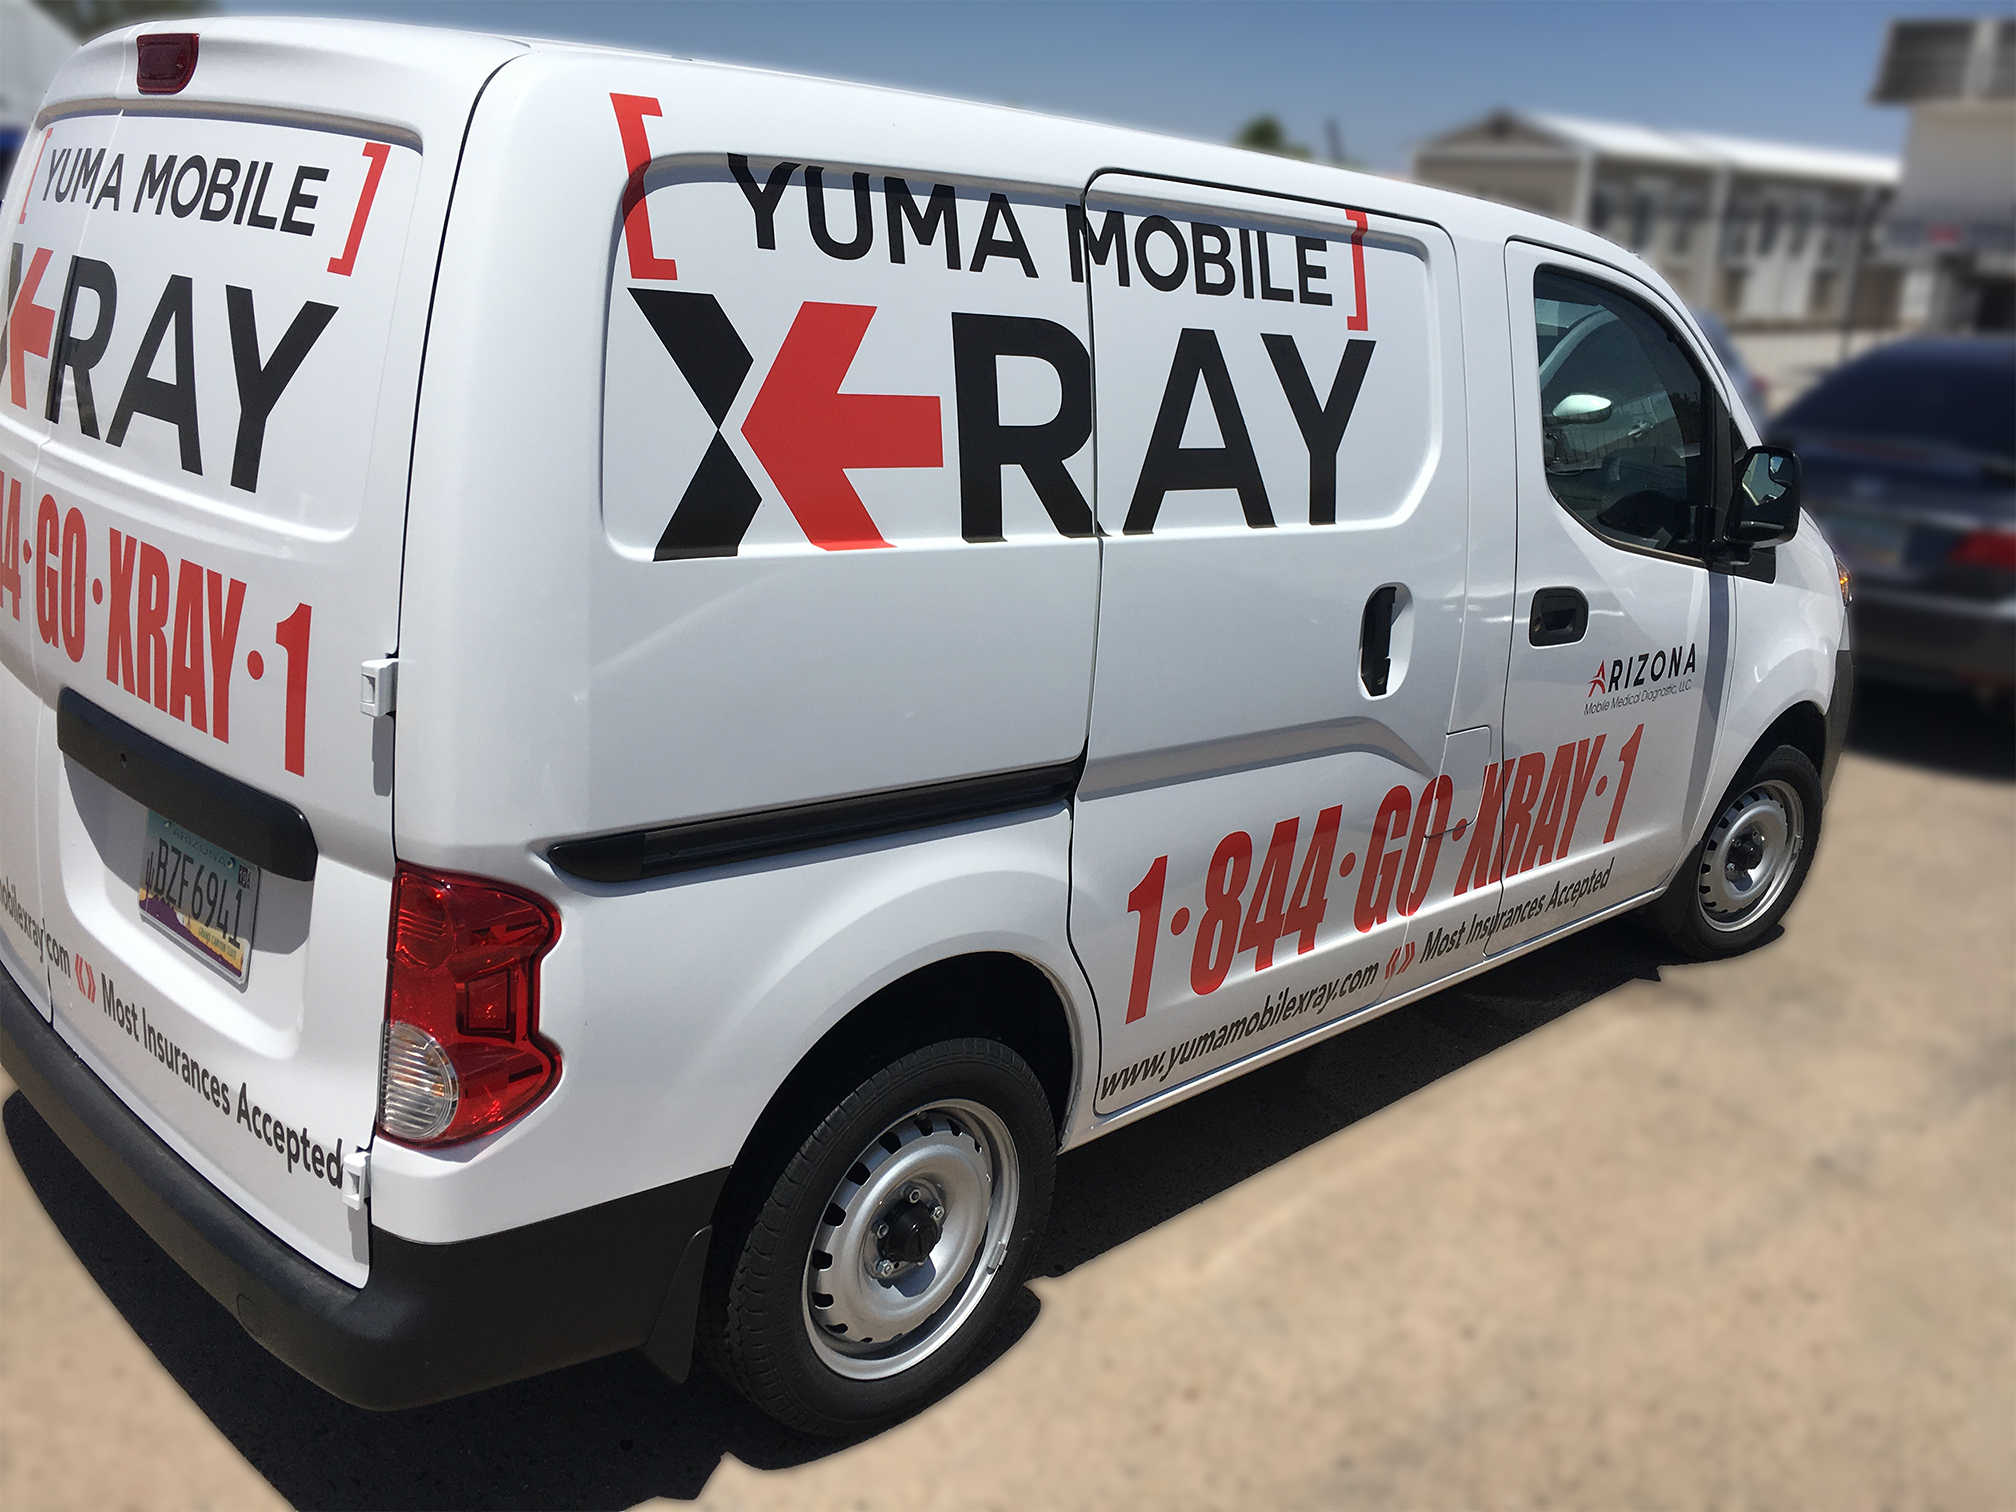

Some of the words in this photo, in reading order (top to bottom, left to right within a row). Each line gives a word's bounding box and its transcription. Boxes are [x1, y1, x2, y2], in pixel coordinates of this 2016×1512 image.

[42, 147, 126, 212] YUMA
[132, 153, 330, 237] MOBILE
[726, 152, 1039, 279] YUMA
[1065, 203, 1334, 307] MOBILE
[1584, 702, 1611, 716] Mobile
[1588, 642, 1696, 698] ARIZONA
[154, 838, 241, 949] BZF6941
[172, 828, 227, 868] ARIZONA
[1099, 961, 1380, 1100] www.yumamobilexray.com
[1419, 921, 1467, 964] Most
[1465, 896, 1544, 944] Insurances
[1545, 856, 1615, 913] Accepted
[101, 972, 140, 1042] Most
[142, 1006, 231, 1115] Insurances
[236, 1082, 343, 1189] Accepted
